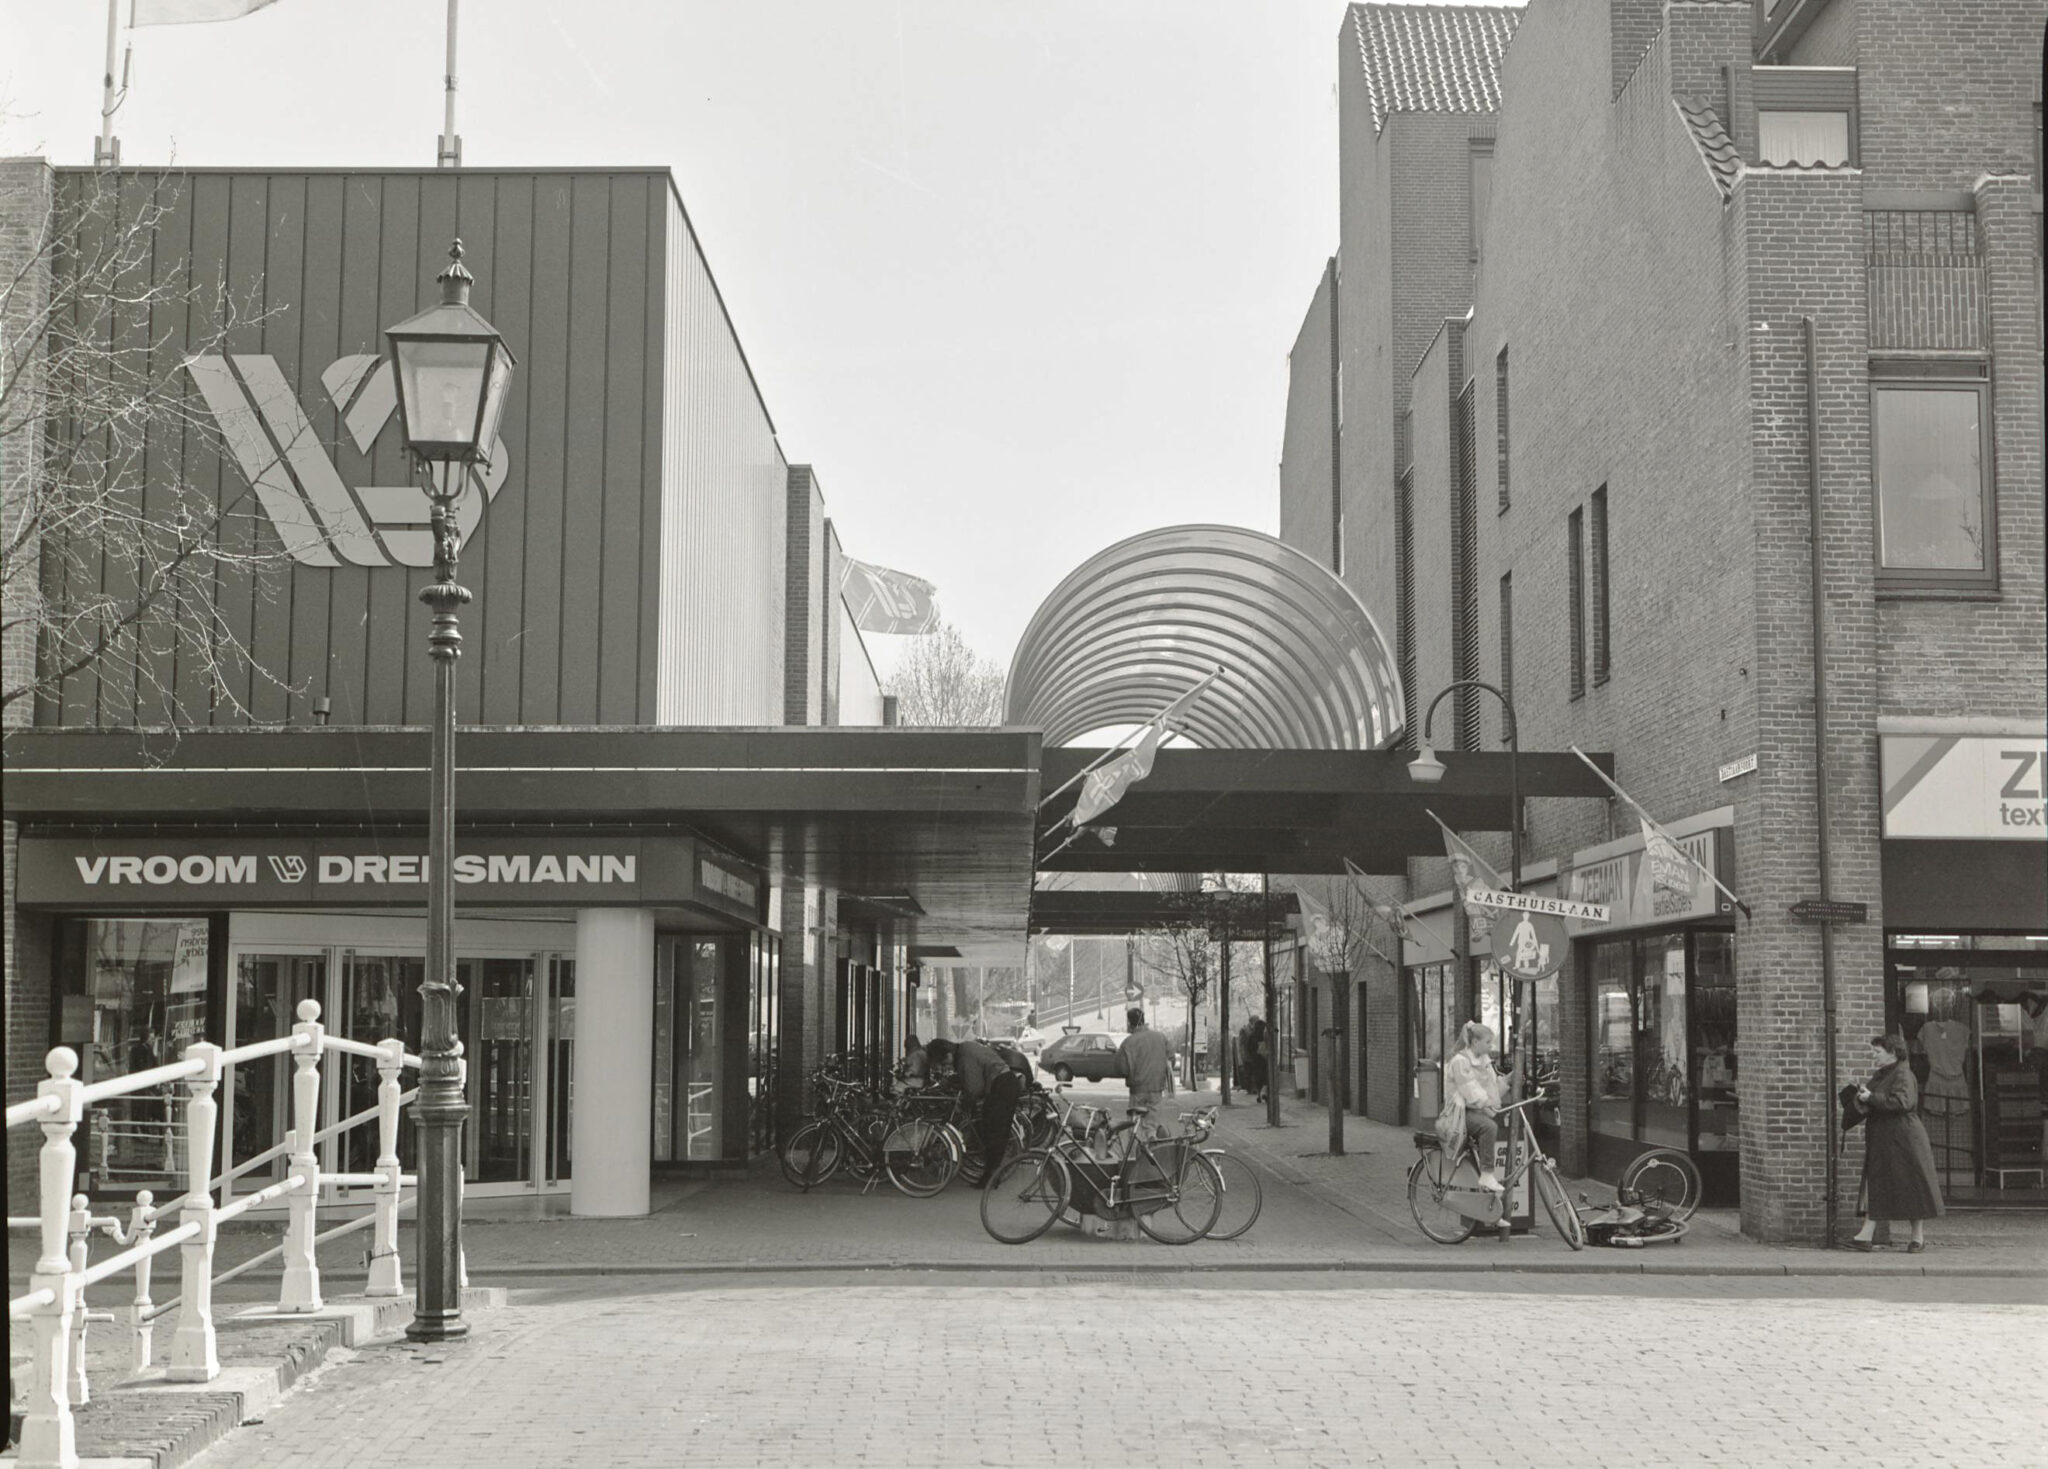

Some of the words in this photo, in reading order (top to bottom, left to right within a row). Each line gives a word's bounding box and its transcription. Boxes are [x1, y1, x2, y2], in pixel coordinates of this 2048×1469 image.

[2000, 751, 2047, 799] Z
[75, 855, 257, 885] VROOM
[318, 854, 636, 884] DRESMANN
[1581, 860, 1623, 905] ZEEMAN
[1651, 860, 1690, 882] EMAN
